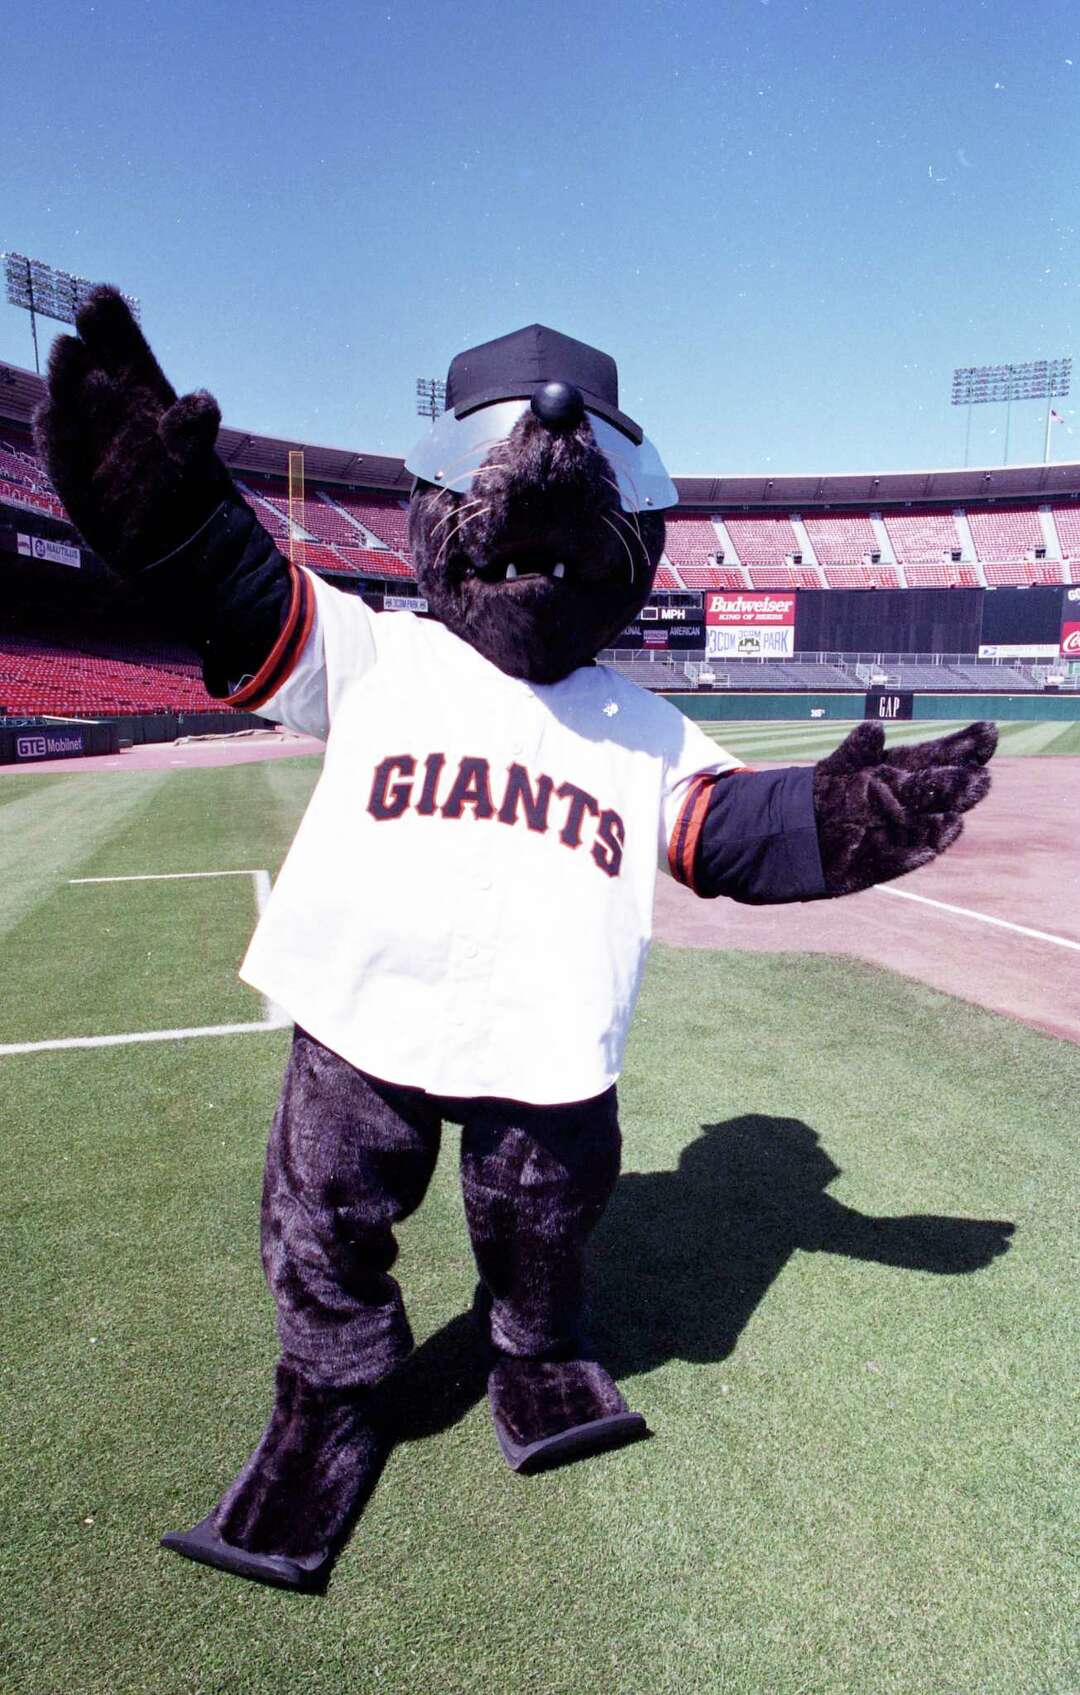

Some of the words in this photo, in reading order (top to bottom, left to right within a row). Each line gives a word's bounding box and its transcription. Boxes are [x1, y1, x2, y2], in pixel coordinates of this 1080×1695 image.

[708, 596, 794, 613] Budweiser
[661, 609, 686, 620] MPH
[669, 625, 700, 636] AMERICAN
[709, 629, 736, 653] 3COM
[763, 629, 789, 653] PARK
[879, 696, 900, 718] GAP
[20, 739, 46, 756] GTE
[47, 738, 82, 753] Mobilnet
[366, 752, 626, 878] GIANTS
